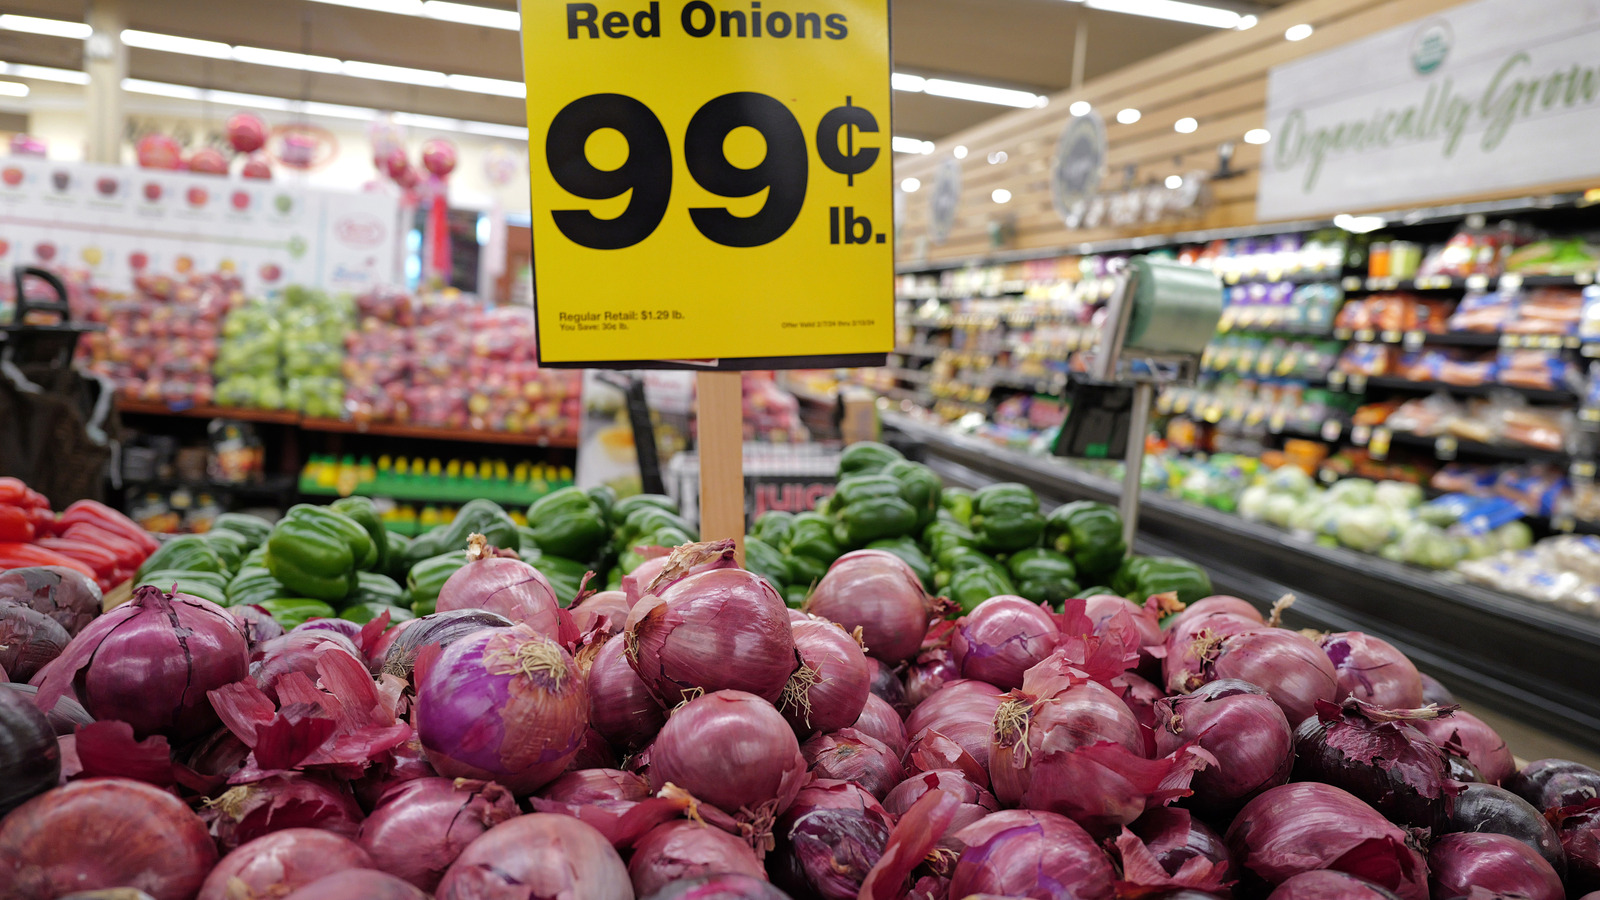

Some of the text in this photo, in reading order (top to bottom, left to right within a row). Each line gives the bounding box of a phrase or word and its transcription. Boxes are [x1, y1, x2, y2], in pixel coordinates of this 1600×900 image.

[566, 1, 848, 40] Red Onions
[829, 206, 886, 245] lb.
[559, 310, 685, 323] Regular Retail: $1.29 lb.
[559, 323, 576, 331] You
[578, 323, 599, 331] Save:
[619, 322, 629, 330] lb.
[753, 484, 836, 517] JUIC
